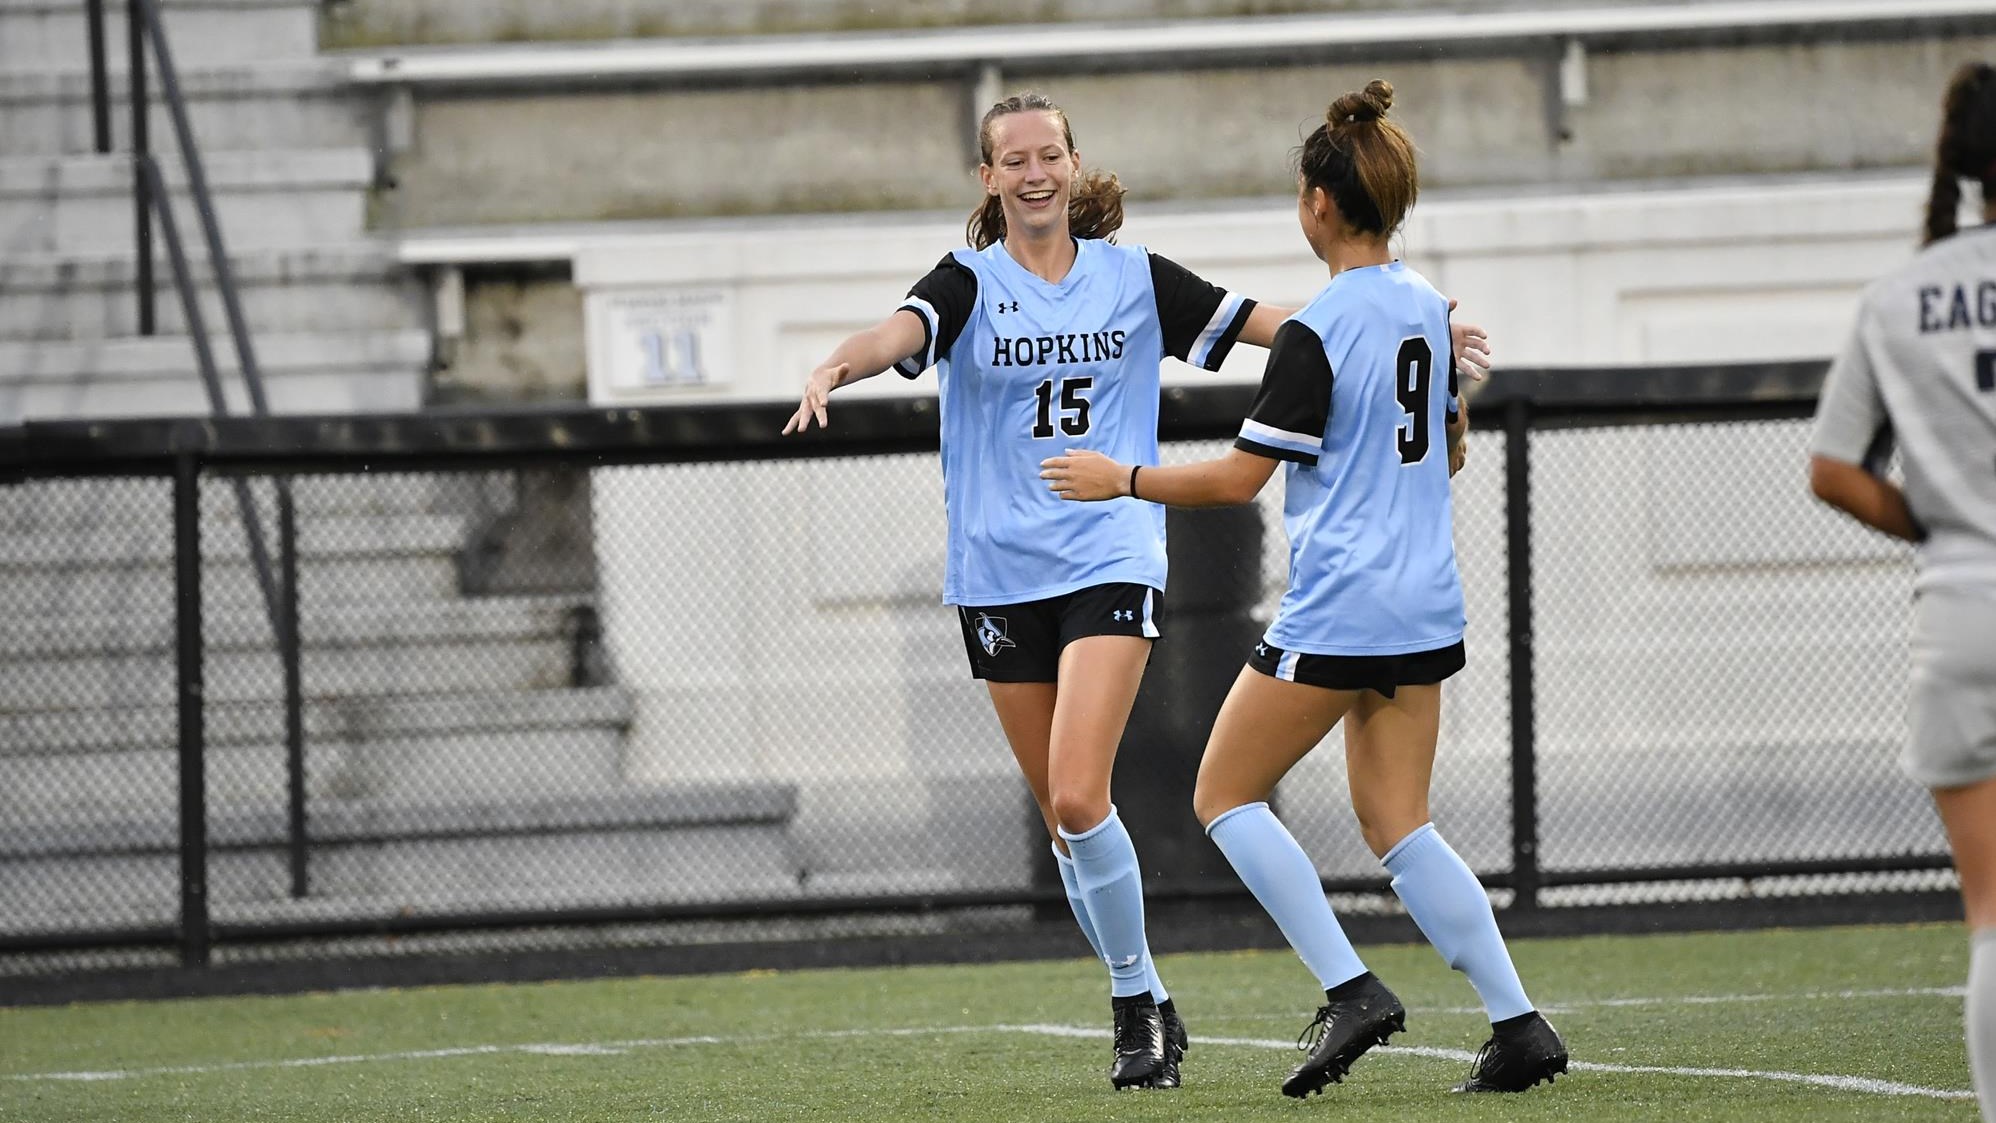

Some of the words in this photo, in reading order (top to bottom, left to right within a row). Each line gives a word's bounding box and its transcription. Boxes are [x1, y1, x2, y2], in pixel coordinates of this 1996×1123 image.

[641, 330, 706, 387] 11
[992, 330, 1125, 367] HOPKINS
[1033, 377, 1093, 438] 15
[1395, 336, 1432, 466] 9
